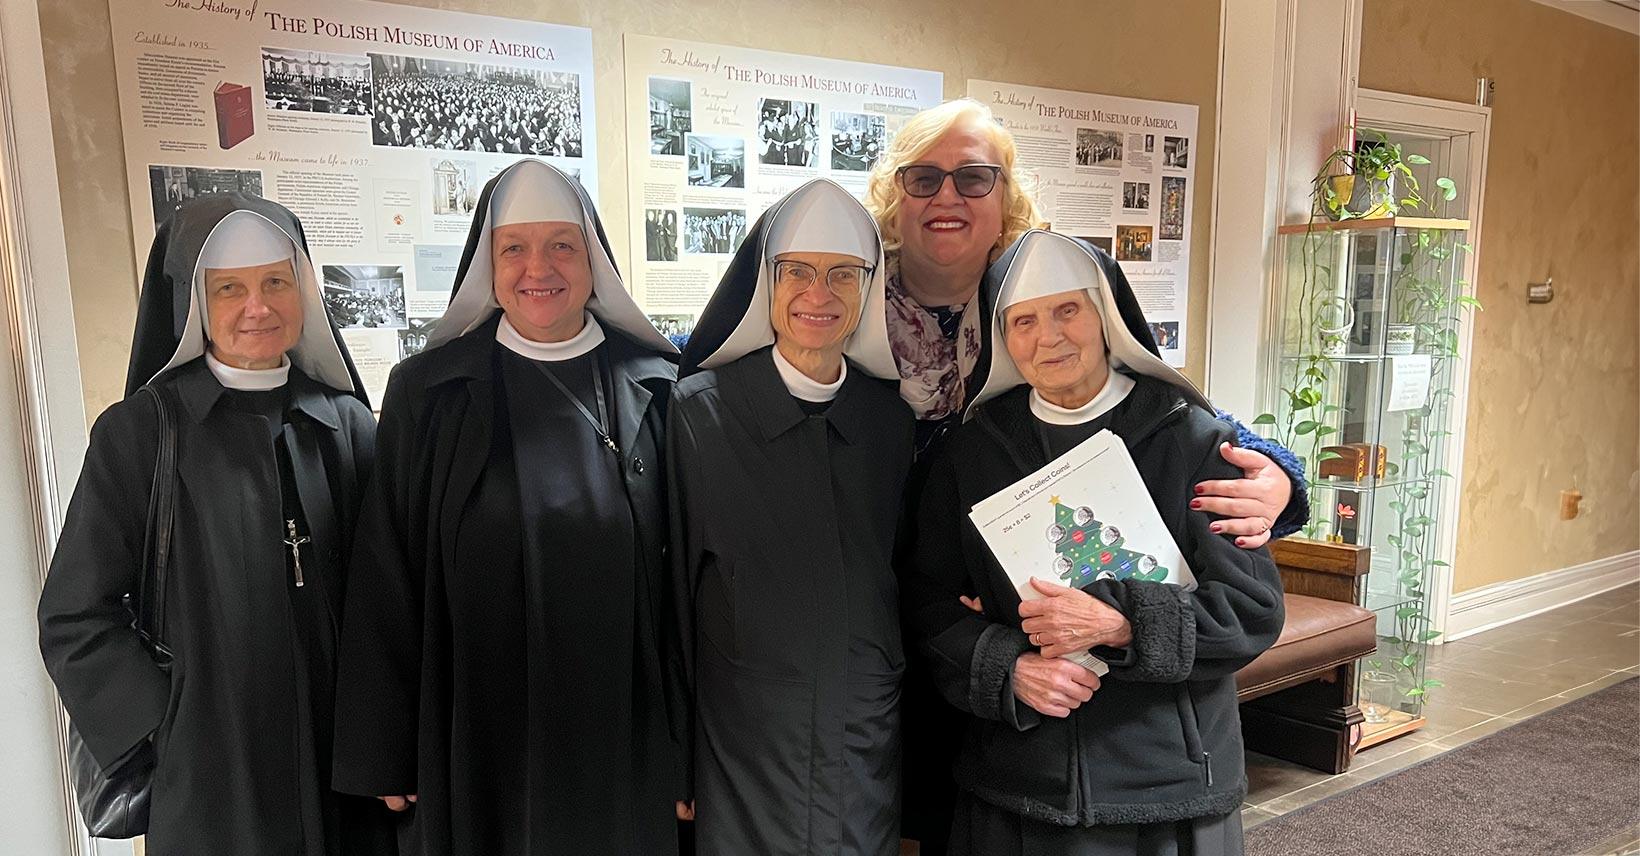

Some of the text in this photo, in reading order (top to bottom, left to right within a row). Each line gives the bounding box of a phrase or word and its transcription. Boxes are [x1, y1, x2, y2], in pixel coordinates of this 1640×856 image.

[192, 0, 241, 20] History
[245, 0, 258, 21] of
[134, 31, 177, 47] Established
[264, 12, 556, 61] THE POLISH MUSEUM OF AMERICA
[660, 48, 721, 73] The History of
[723, 65, 917, 101] THE POLISH MUSEUM OF AMERICA
[1036, 103, 1178, 130] THE POLISH MUSEUM OF AMERICA
[1014, 461, 1071, 501] Let's Collect Coins!
